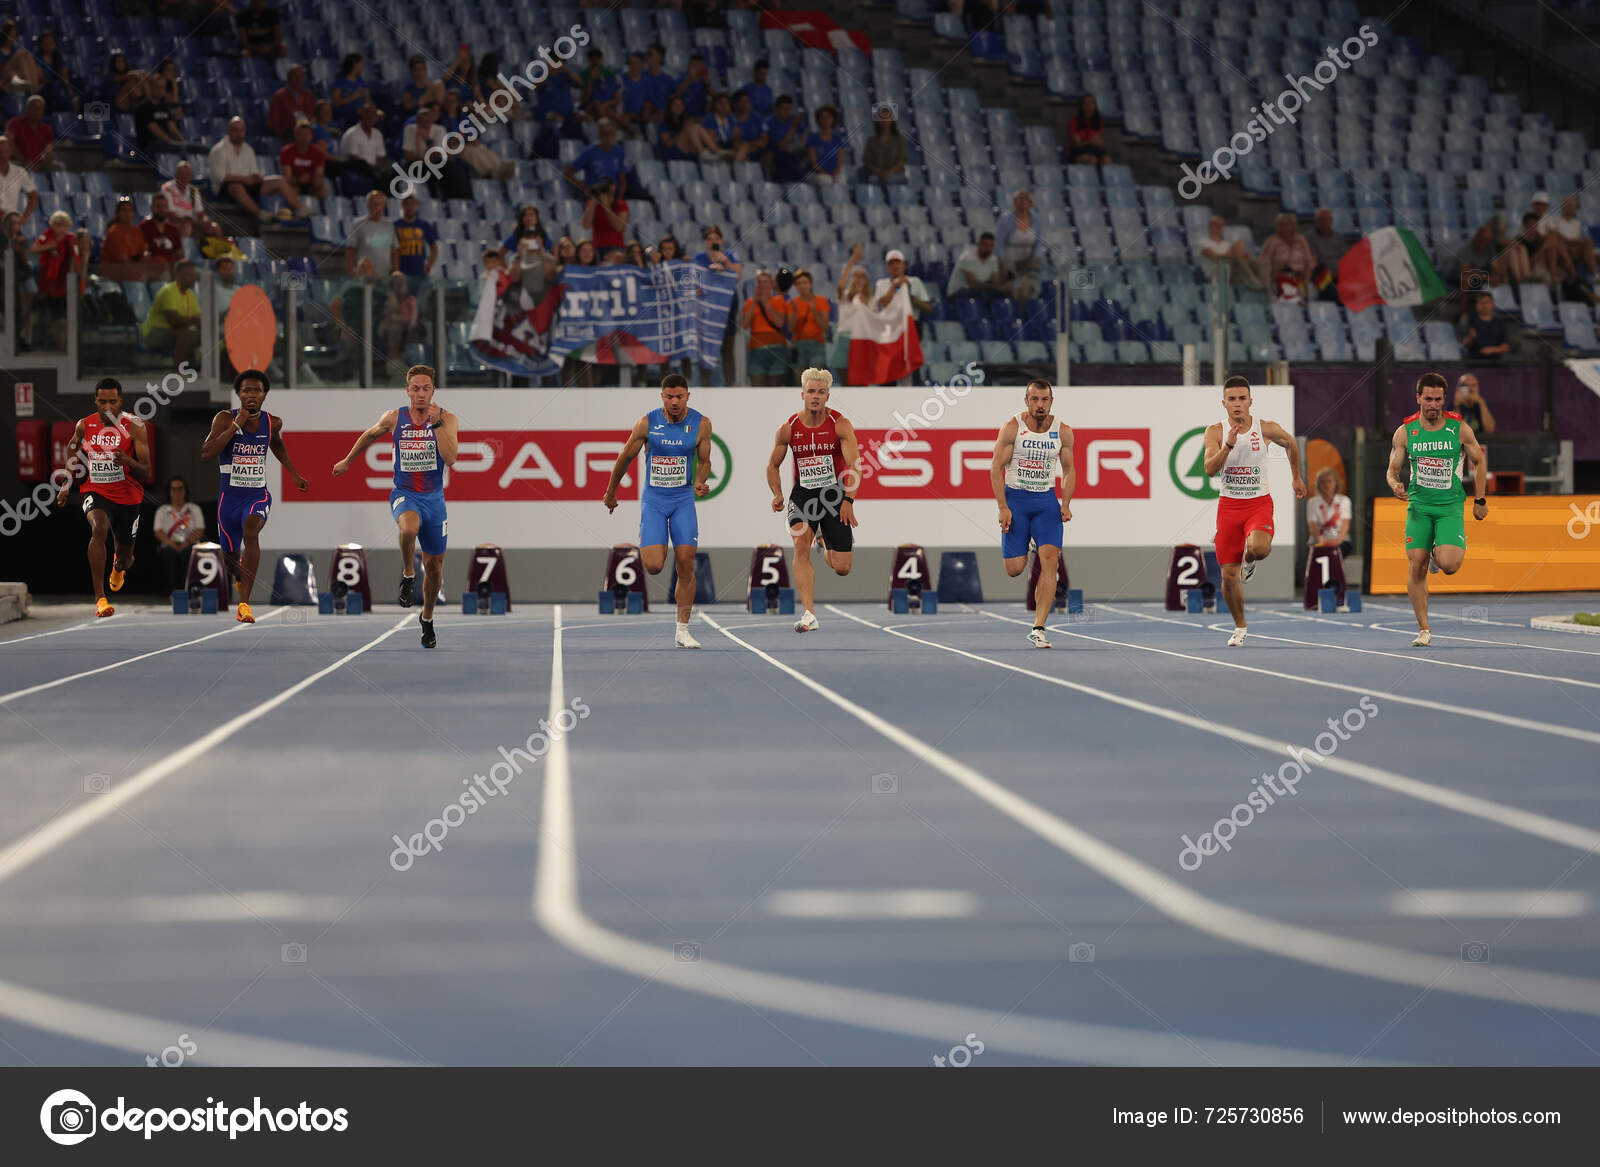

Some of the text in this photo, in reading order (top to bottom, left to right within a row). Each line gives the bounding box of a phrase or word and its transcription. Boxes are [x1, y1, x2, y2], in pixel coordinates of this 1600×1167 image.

[401, 429, 433, 438] SERBIA
[232, 442, 266, 455] FRANCE
[792, 443, 836, 452] DENMARK
[1022, 439, 1056, 450] CZECHIA
[1412, 441, 1454, 452] PORTUGAL
[233, 456, 258, 464] SPAR
[652, 456, 678, 465] SPAR
[798, 457, 823, 467] SPAR
[878, 439, 1144, 487] SPR
[1018, 459, 1044, 469] SPAR
[1419, 457, 1445, 467] SPAR
[91, 462, 120, 472] REAIS
[232, 466, 264, 475] MATEO
[652, 466, 685, 476] MELLUZZO
[800, 464, 833, 477] HANSEN
[1418, 465, 1451, 477] NASCIMENTO
[197, 557, 218, 585] 9
[337, 557, 360, 586] 8
[476, 557, 497, 583] 7
[615, 557, 637, 585] 6
[760, 556, 780, 585] 5
[897, 557, 922, 580] 4
[1177, 556, 1199, 585] 2
[1315, 556, 1330, 585] 1
